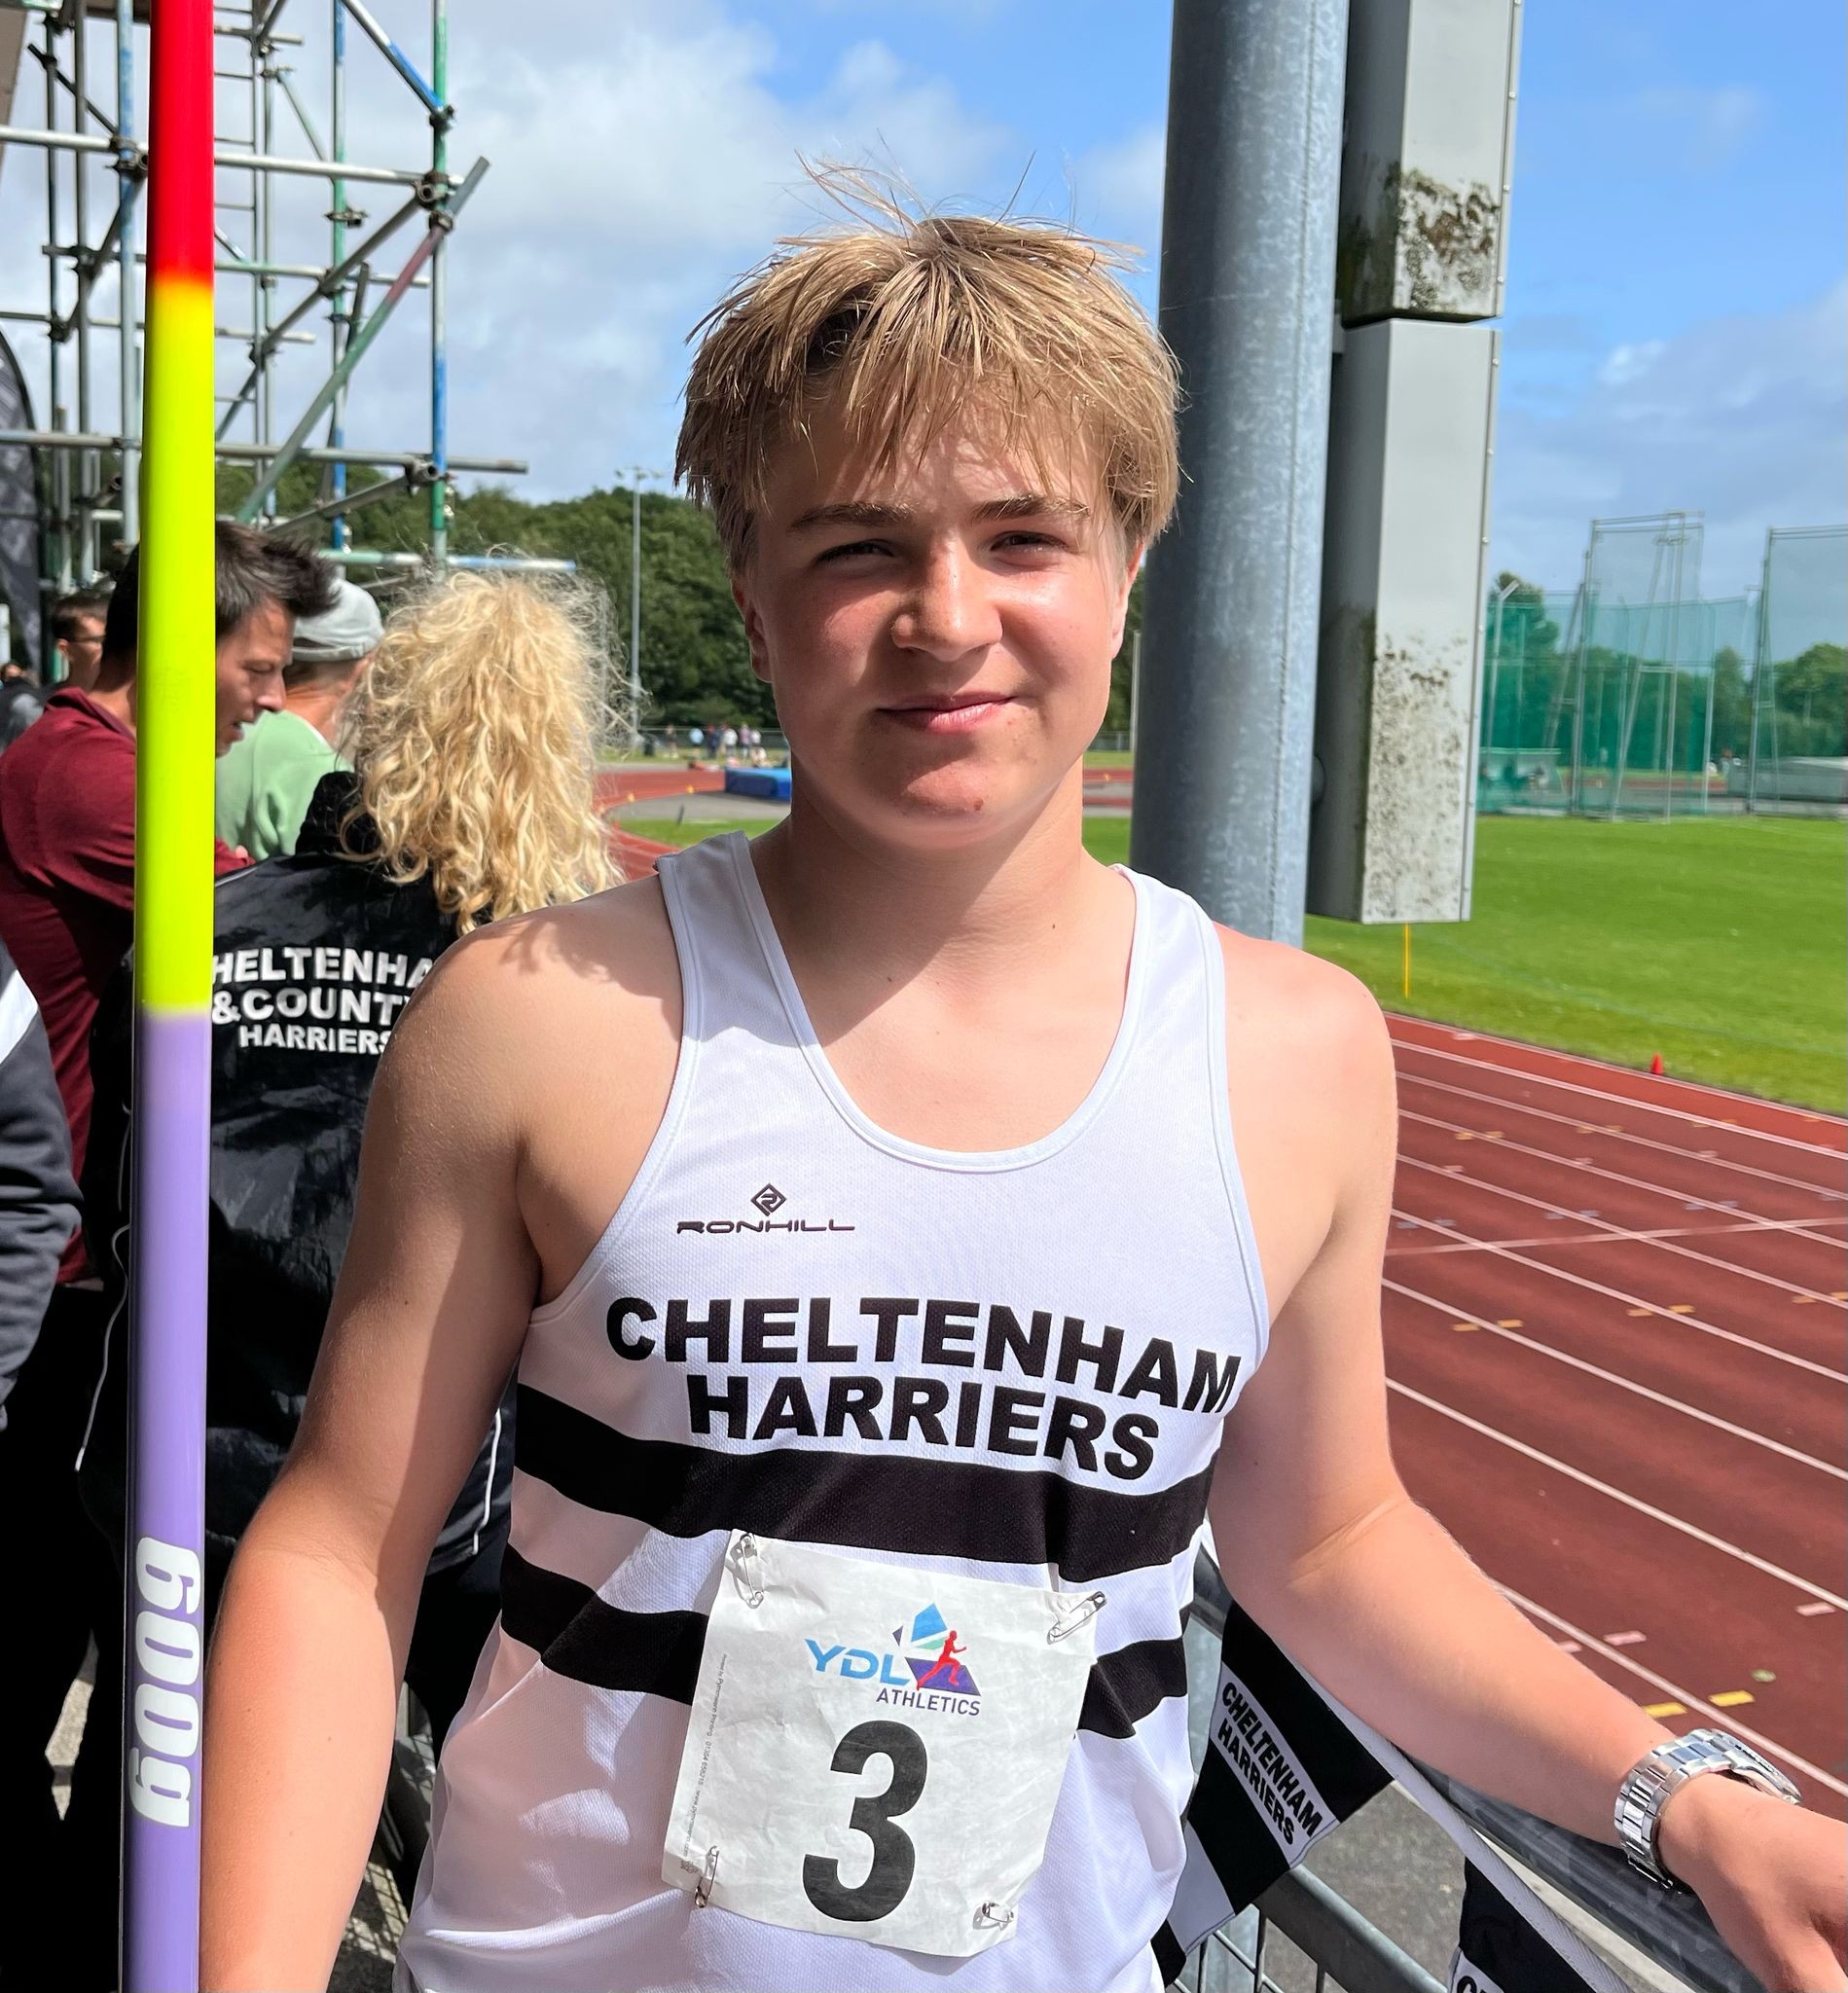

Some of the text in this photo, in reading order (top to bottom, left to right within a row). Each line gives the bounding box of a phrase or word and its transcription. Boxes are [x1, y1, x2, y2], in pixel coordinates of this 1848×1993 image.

[212, 947, 435, 989] HELTENHA
[676, 1218, 855, 1235] RONHILL
[605, 1296, 1241, 1414] CHELTENHAM
[686, 1374, 1160, 1481] HARRIERS
[129, 1537, 201, 1828] 600g
[805, 1638, 910, 1686] YDL
[876, 1687, 981, 1717] ATHLETICS
[1217, 1718, 1294, 1845] HARRIERS
[1222, 1683, 1323, 1838] CHELTENHAM
[802, 1720, 928, 1922] 3
